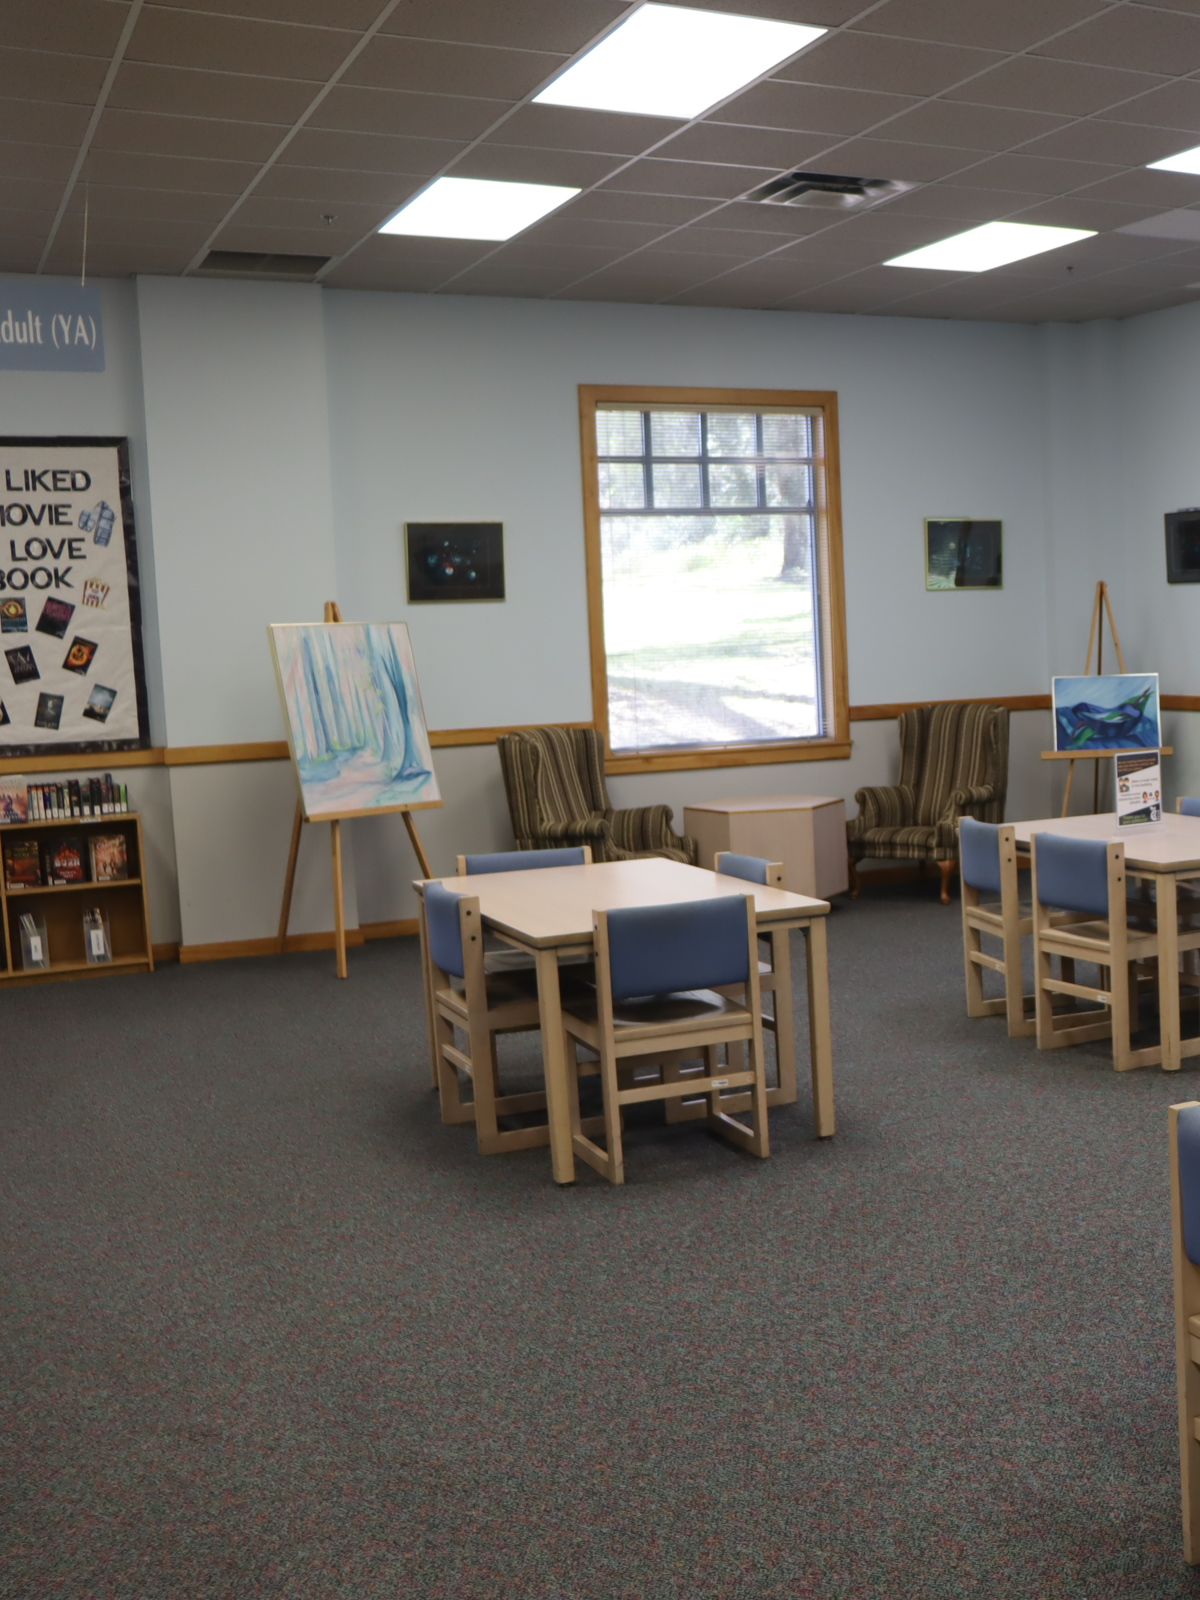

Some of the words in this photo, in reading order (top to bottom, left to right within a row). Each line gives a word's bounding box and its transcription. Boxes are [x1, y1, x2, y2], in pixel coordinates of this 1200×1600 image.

[0, 309, 43, 344] dult
[51, 313, 96, 350] (YA)
[5, 469, 91, 492] LIKED
[10, 537, 87, 562] LOVE
